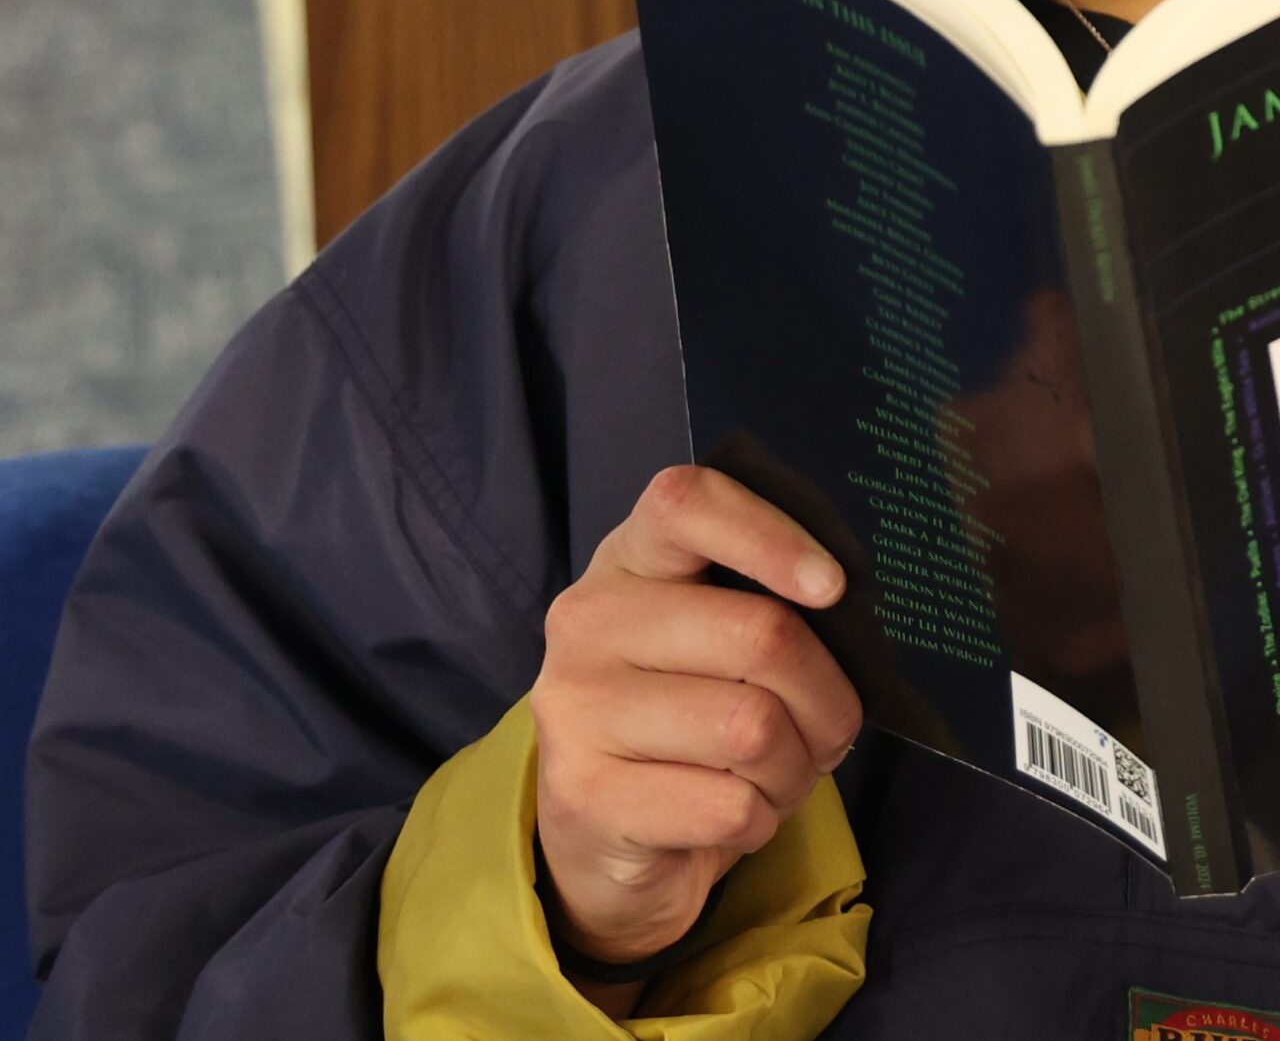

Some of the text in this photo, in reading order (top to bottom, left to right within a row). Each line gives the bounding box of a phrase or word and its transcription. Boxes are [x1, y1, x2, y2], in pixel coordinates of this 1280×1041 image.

[1218, 304, 1246, 324] The
[856, 417, 909, 447] WILLIAM
[877, 442, 922, 470] ROBERT
[847, 469, 904, 499] GEORGIA
[895, 466, 928, 491] JOHN
[869, 494, 928, 524] CLAYTON
[880, 517, 915, 538] MARK
[872, 531, 922, 559] GEORGE
[875, 568, 934, 598] GORDON
[938, 588, 963, 607] VAN
[876, 551, 992, 603] HUNTER SPURLOCK
[1256, 591, 1274, 634] Zodiac
[874, 604, 1001, 654] PHILIP LEE WILLIAMS
[882, 624, 993, 669] WILLIAM WRIGHT
[1262, 630, 1278, 658] The
[1020, 708, 1042, 726] ISBN
[1186, 1014, 1270, 1039] CHARLES
